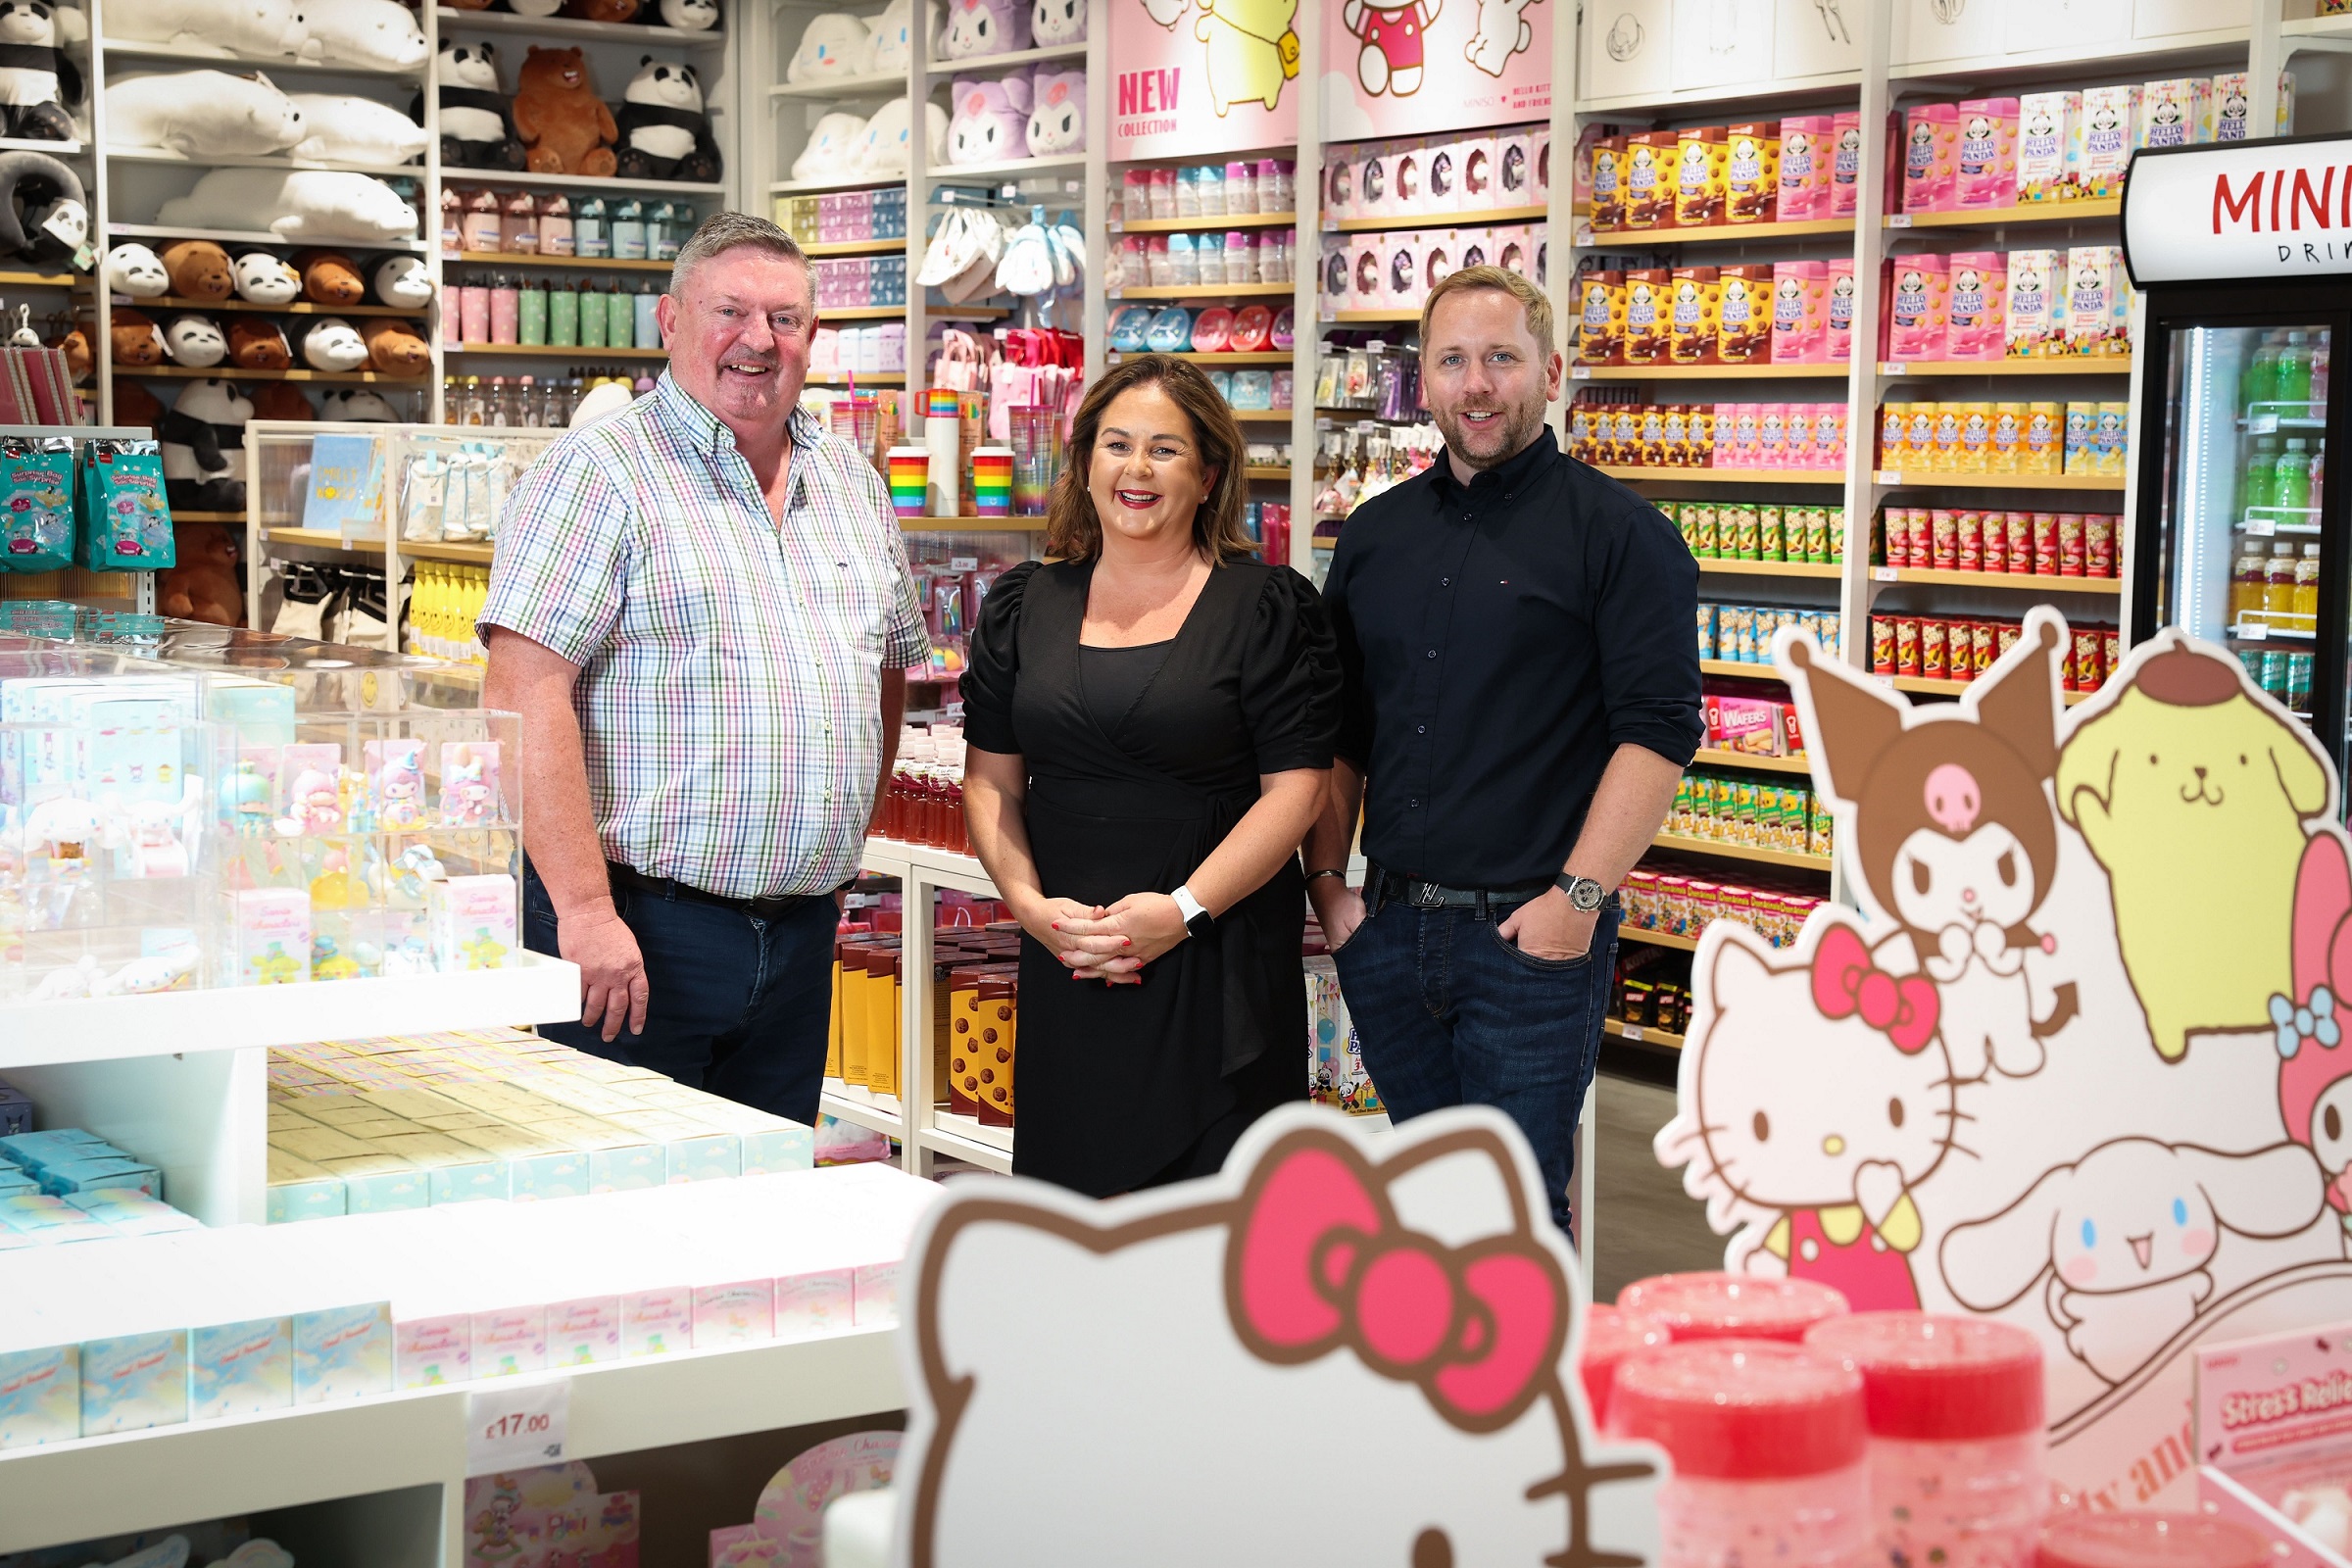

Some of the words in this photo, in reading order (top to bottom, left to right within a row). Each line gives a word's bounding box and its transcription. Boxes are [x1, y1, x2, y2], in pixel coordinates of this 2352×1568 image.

[1119, 68, 1180, 116] NEW
[1118, 119, 1176, 137] COLLECTION
[2151, 125, 2183, 136] HELLO
[2219, 121, 2244, 130] HELL
[2149, 135, 2184, 146] PANDA
[2218, 130, 2245, 140] PAND
[1953, 294, 1983, 303] HELLO
[1952, 303, 1984, 313] PANDA
[11, 470, 45, 479] Surprise
[46, 470, 63, 480] Bag
[1724, 710, 1767, 728] WAFERS
[2223, 1384, 2300, 1429] Stress
[486, 1413, 549, 1440] £17.00
